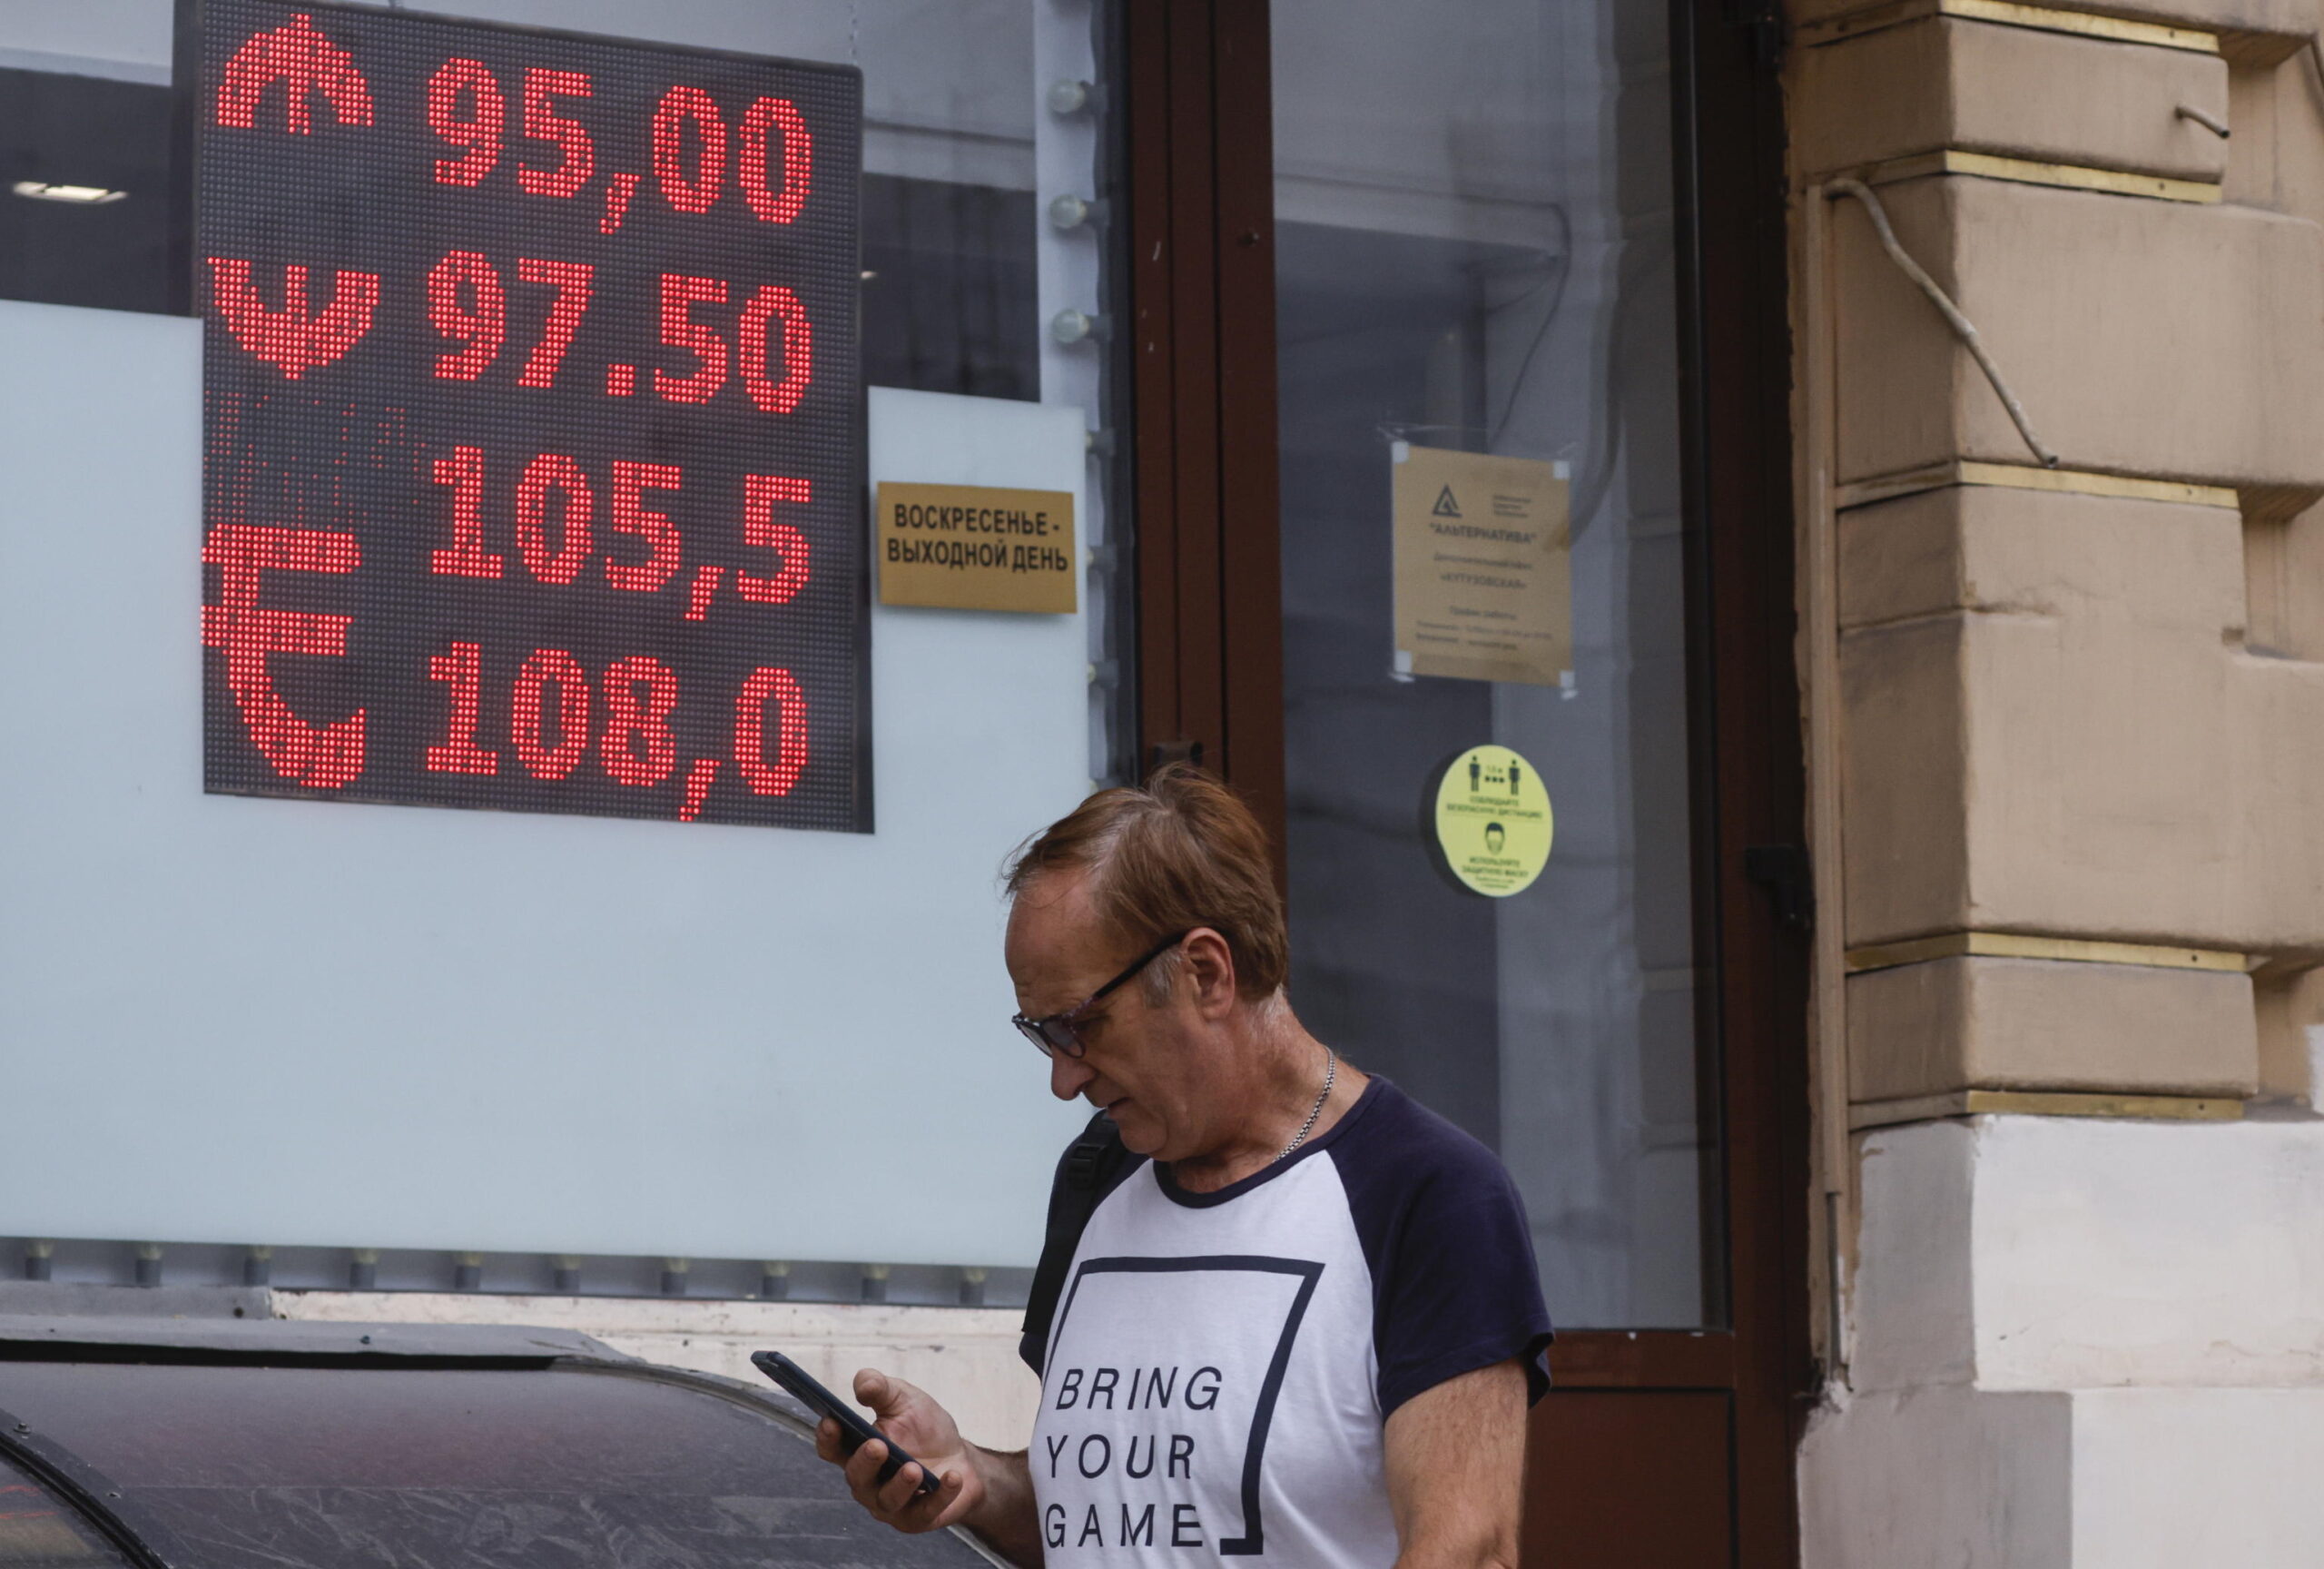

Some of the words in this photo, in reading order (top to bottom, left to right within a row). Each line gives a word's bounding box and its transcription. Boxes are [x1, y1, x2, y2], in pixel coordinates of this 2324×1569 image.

[428, 57, 812, 235] 95,00
[428, 250, 812, 414] 97.50
[430, 446, 812, 621] 105,5
[894, 503, 1048, 537] ВОСКРЕСЕНЬЕ
[887, 538, 1008, 571] ВЫХОДНОЙ
[1012, 546, 1068, 574] ДЕНЬ
[427, 642, 811, 823] 108,0
[1056, 1366, 1222, 1411] BRING
[1046, 1434, 1195, 1480] YOUR
[1045, 1503, 1203, 1549] GAME
